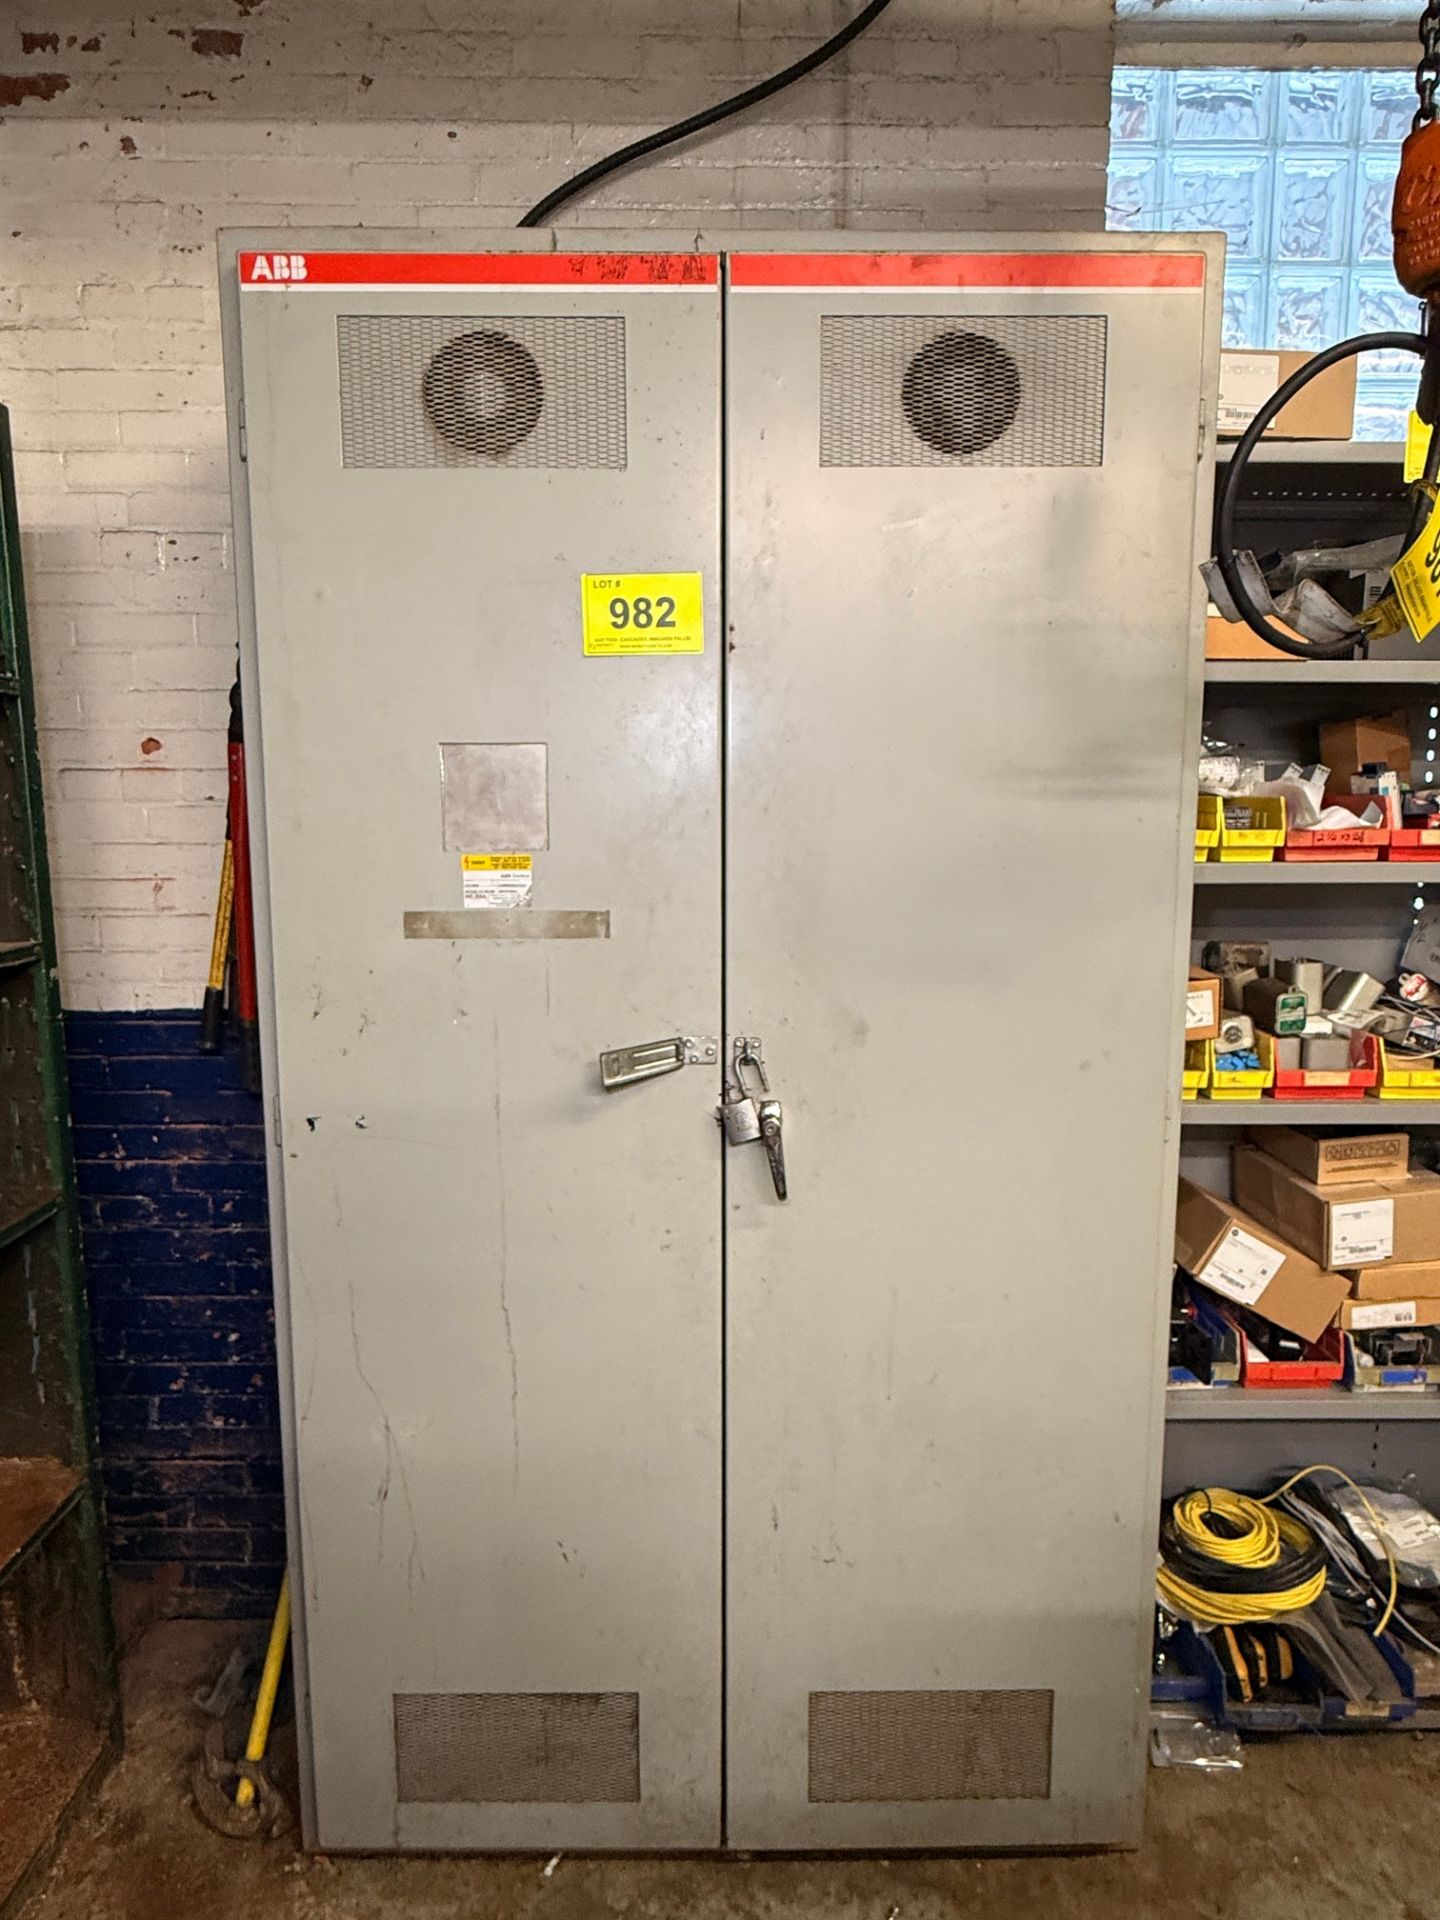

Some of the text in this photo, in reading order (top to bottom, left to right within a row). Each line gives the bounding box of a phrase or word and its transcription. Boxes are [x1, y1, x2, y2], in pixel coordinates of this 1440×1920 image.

[250, 254, 308, 280] ABB
[593, 579, 621, 589] LOT #
[609, 596, 676, 629] 982
